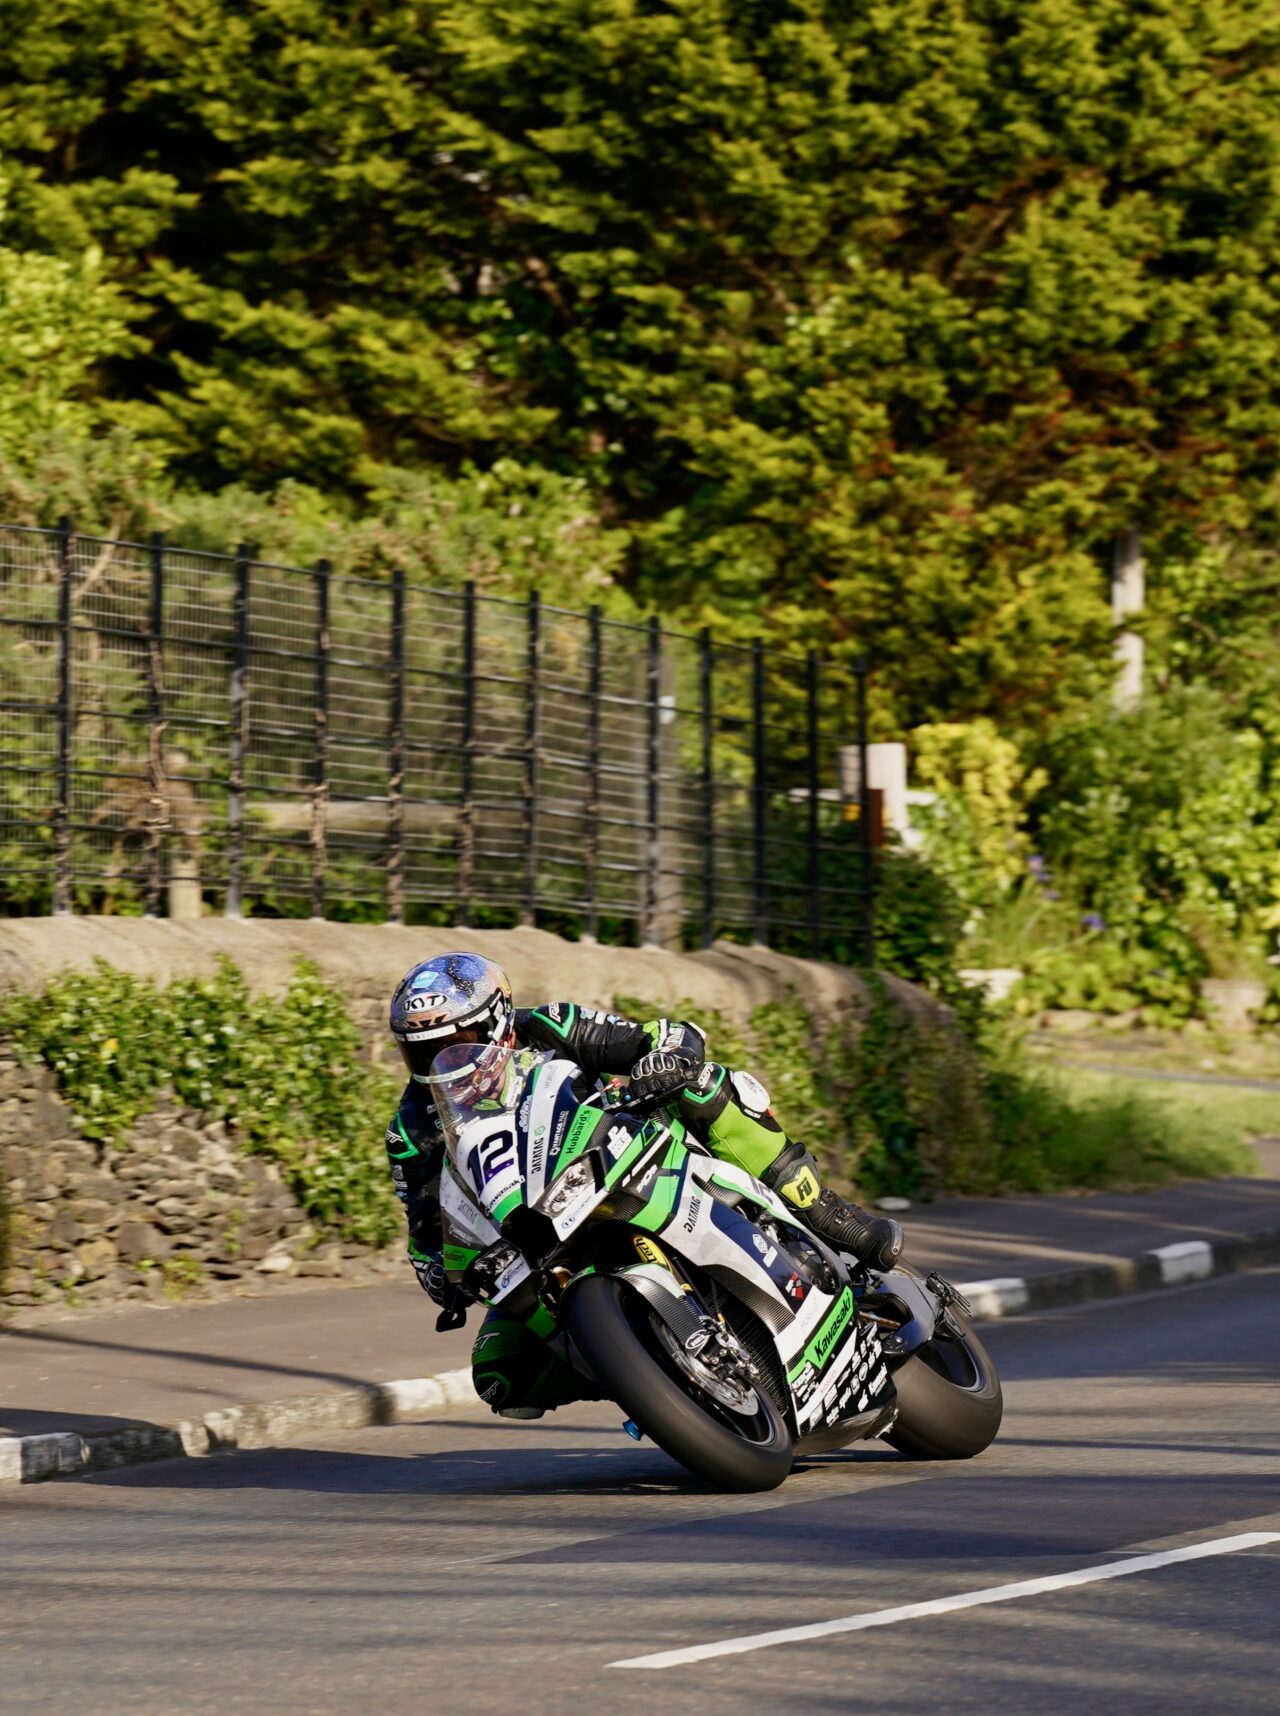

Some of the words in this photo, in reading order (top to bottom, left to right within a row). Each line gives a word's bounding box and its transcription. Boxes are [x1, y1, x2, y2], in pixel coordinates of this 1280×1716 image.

[404, 995, 440, 1011] KYT
[566, 1110, 590, 1154] Hubbard's
[467, 1130, 514, 1198] 12
[531, 1137, 544, 1174] DATATAG
[486, 1177, 524, 1214] Kawasaki
[683, 1196, 701, 1233] DATATAG
[814, 1292, 851, 1362] Kawasaki
